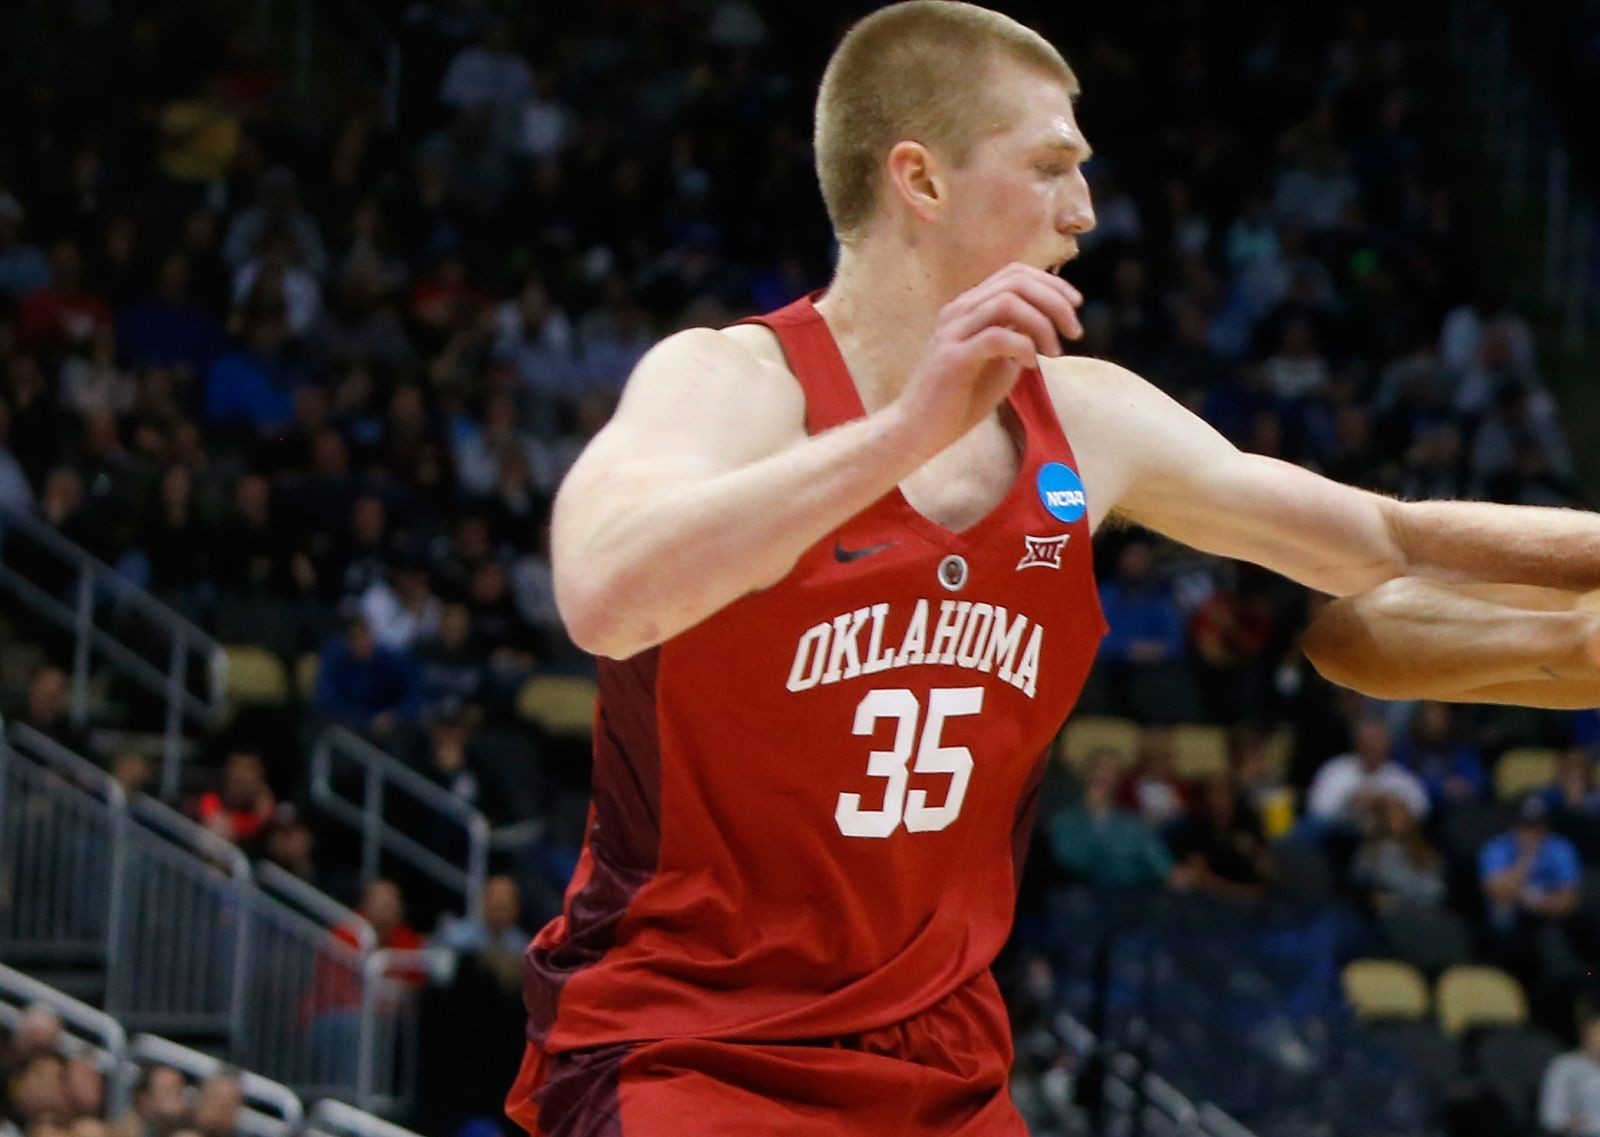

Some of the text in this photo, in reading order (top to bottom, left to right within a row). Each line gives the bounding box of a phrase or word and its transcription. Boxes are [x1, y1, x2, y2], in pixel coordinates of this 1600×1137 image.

[1046, 490, 1086, 507] NCAA
[786, 599, 1044, 698] OKLAHOMA
[834, 687, 984, 838] 35
